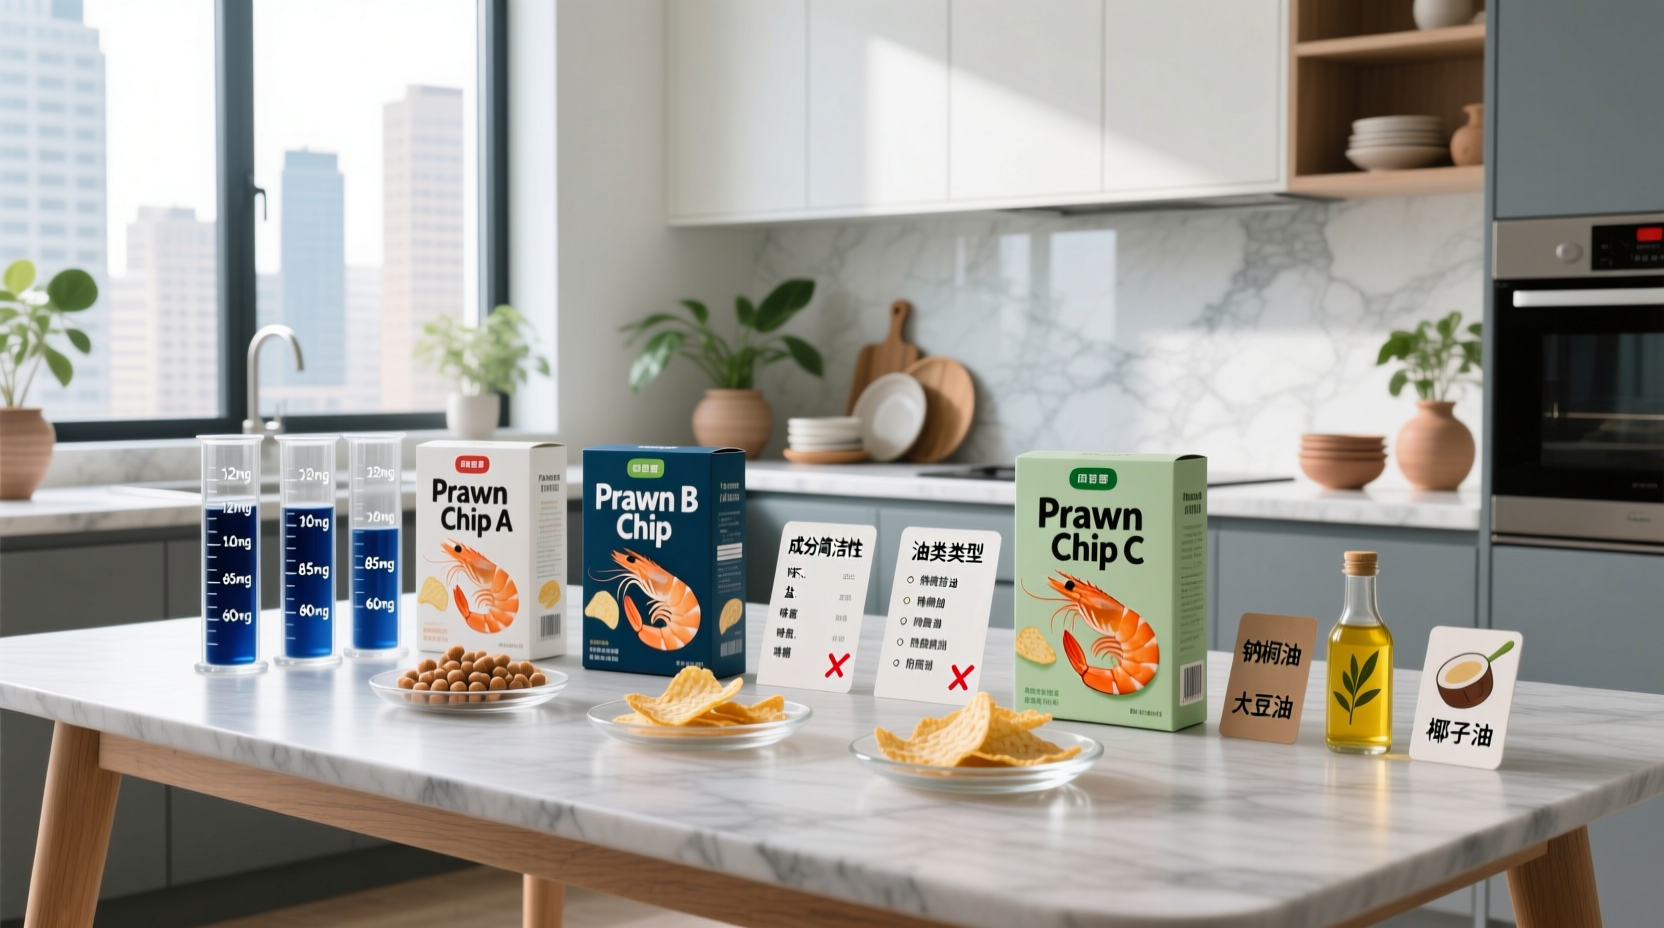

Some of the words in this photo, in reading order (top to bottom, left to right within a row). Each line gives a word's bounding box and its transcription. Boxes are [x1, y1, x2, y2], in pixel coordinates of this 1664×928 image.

[432, 478, 508, 505] Prawn
[595, 482, 675, 512] Prawn
[681, 485, 699, 513] B
[440, 506, 492, 538] Chip
[495, 508, 513, 532] A
[1038, 496, 1143, 531] Prawn
[616, 513, 673, 548] Chip
[911, 540, 984, 564] 油类类型
[1051, 532, 1118, 571] Chip
[1123, 535, 1145, 565] C
[1231, 690, 1294, 720] 大豆油
[1425, 717, 1494, 748] 椰子油
